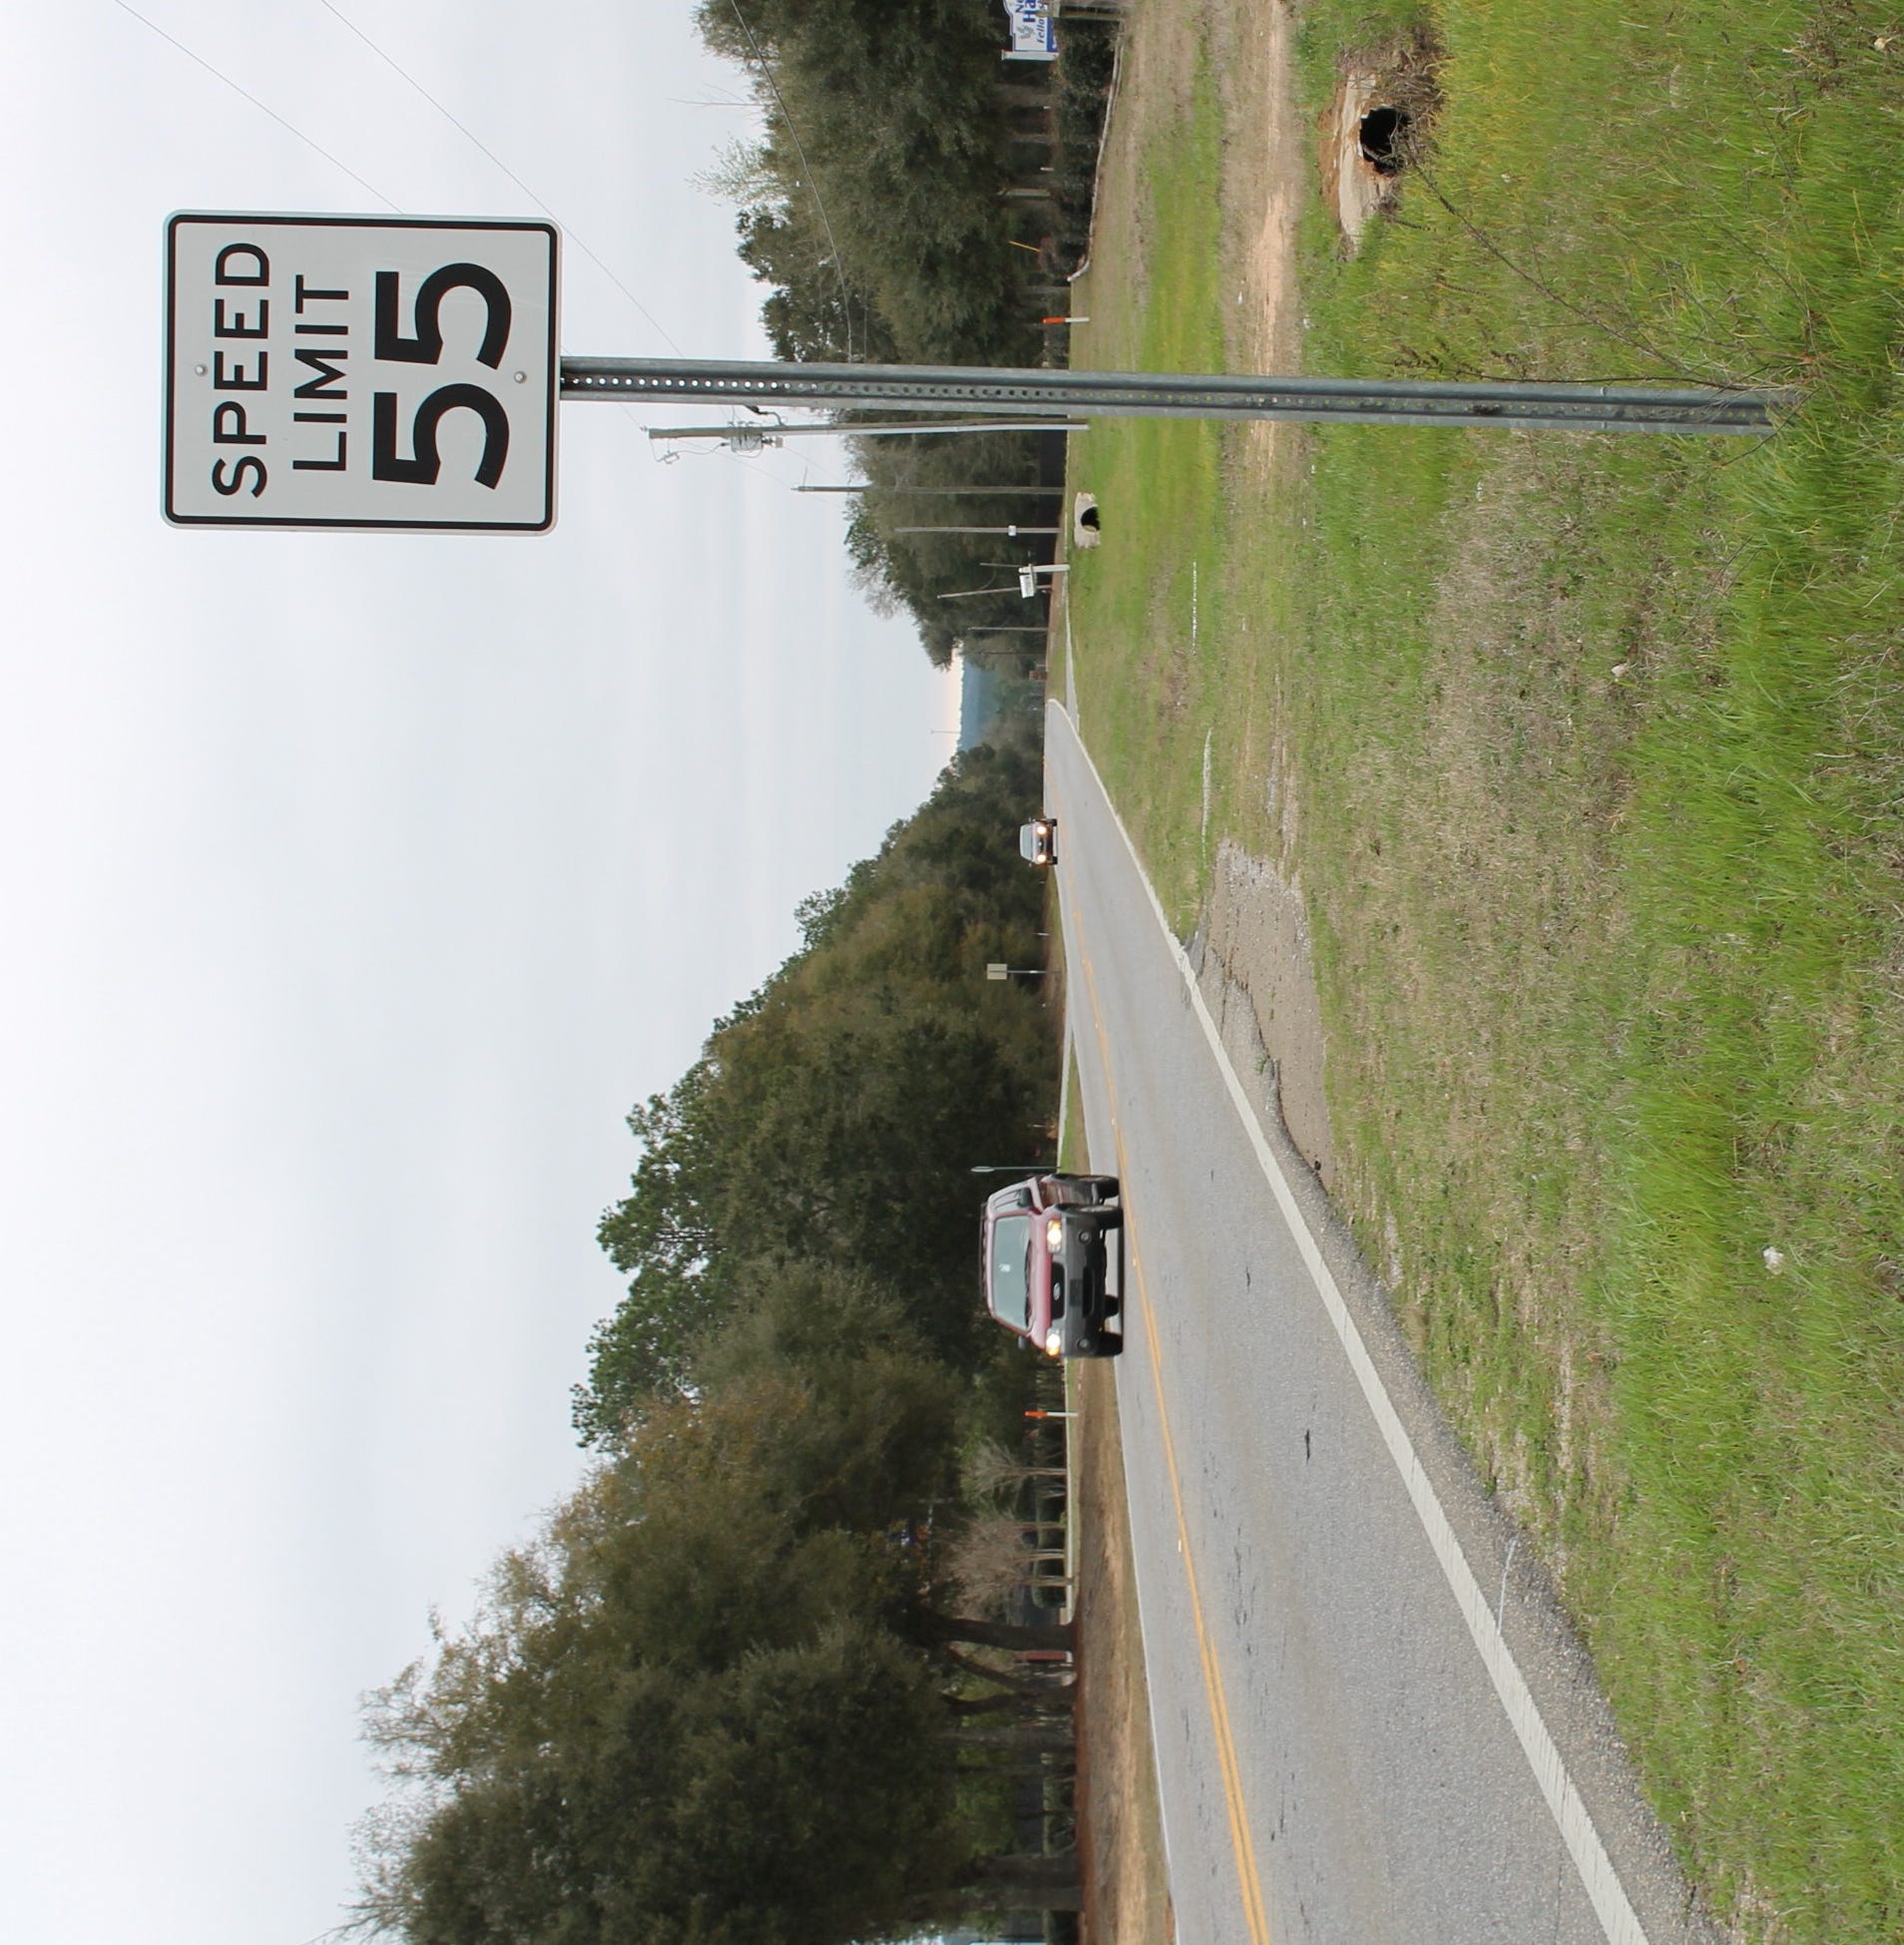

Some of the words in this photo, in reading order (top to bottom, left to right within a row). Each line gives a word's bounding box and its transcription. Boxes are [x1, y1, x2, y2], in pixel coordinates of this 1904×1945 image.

[213, 243, 270, 498] SPEED
[292, 273, 349, 472] LIMIT
[372, 262, 512, 490] 55
